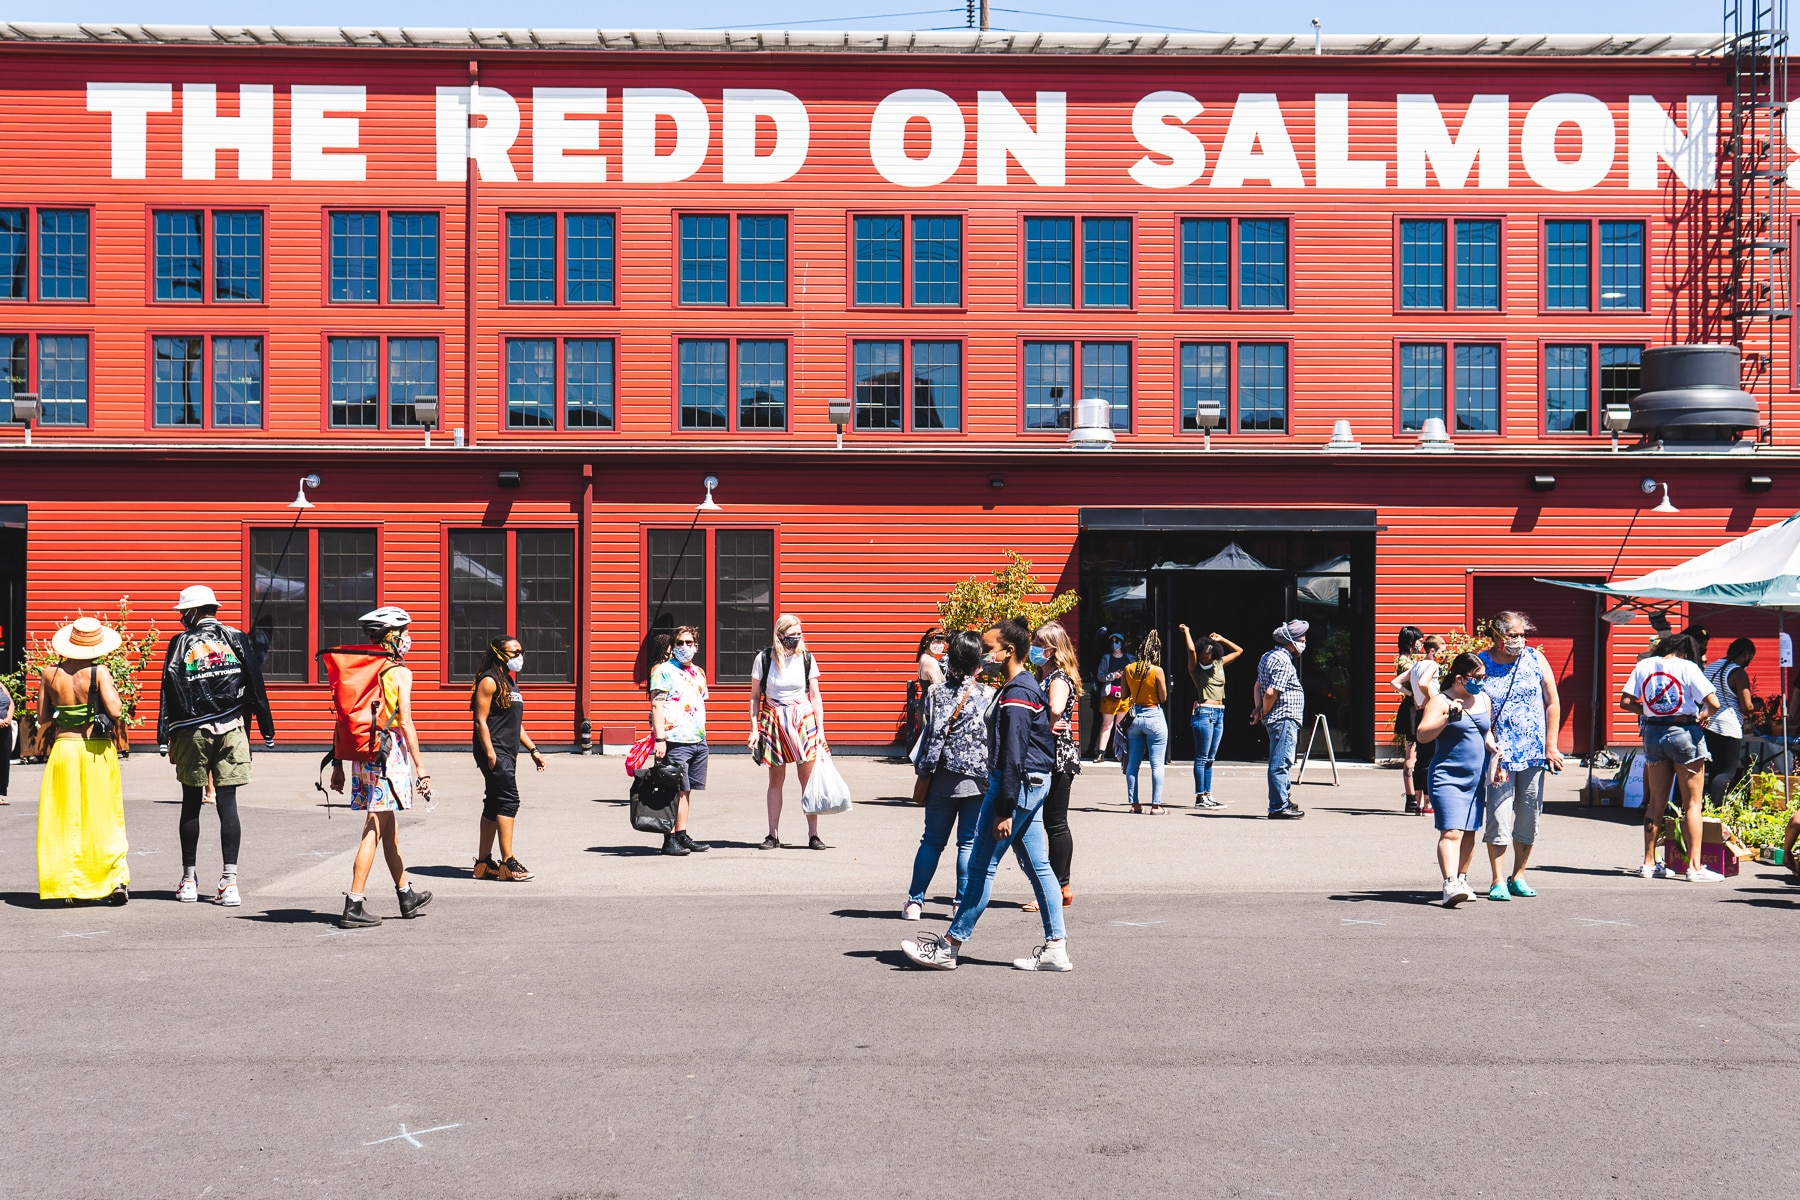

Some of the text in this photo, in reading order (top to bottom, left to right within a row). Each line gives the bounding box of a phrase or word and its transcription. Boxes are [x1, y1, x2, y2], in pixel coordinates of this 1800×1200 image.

[86, 82, 367, 182] THE
[435, 85, 811, 185] REDD
[869, 88, 1067, 188] ON
[1128, 90, 1718, 192] SALMON
